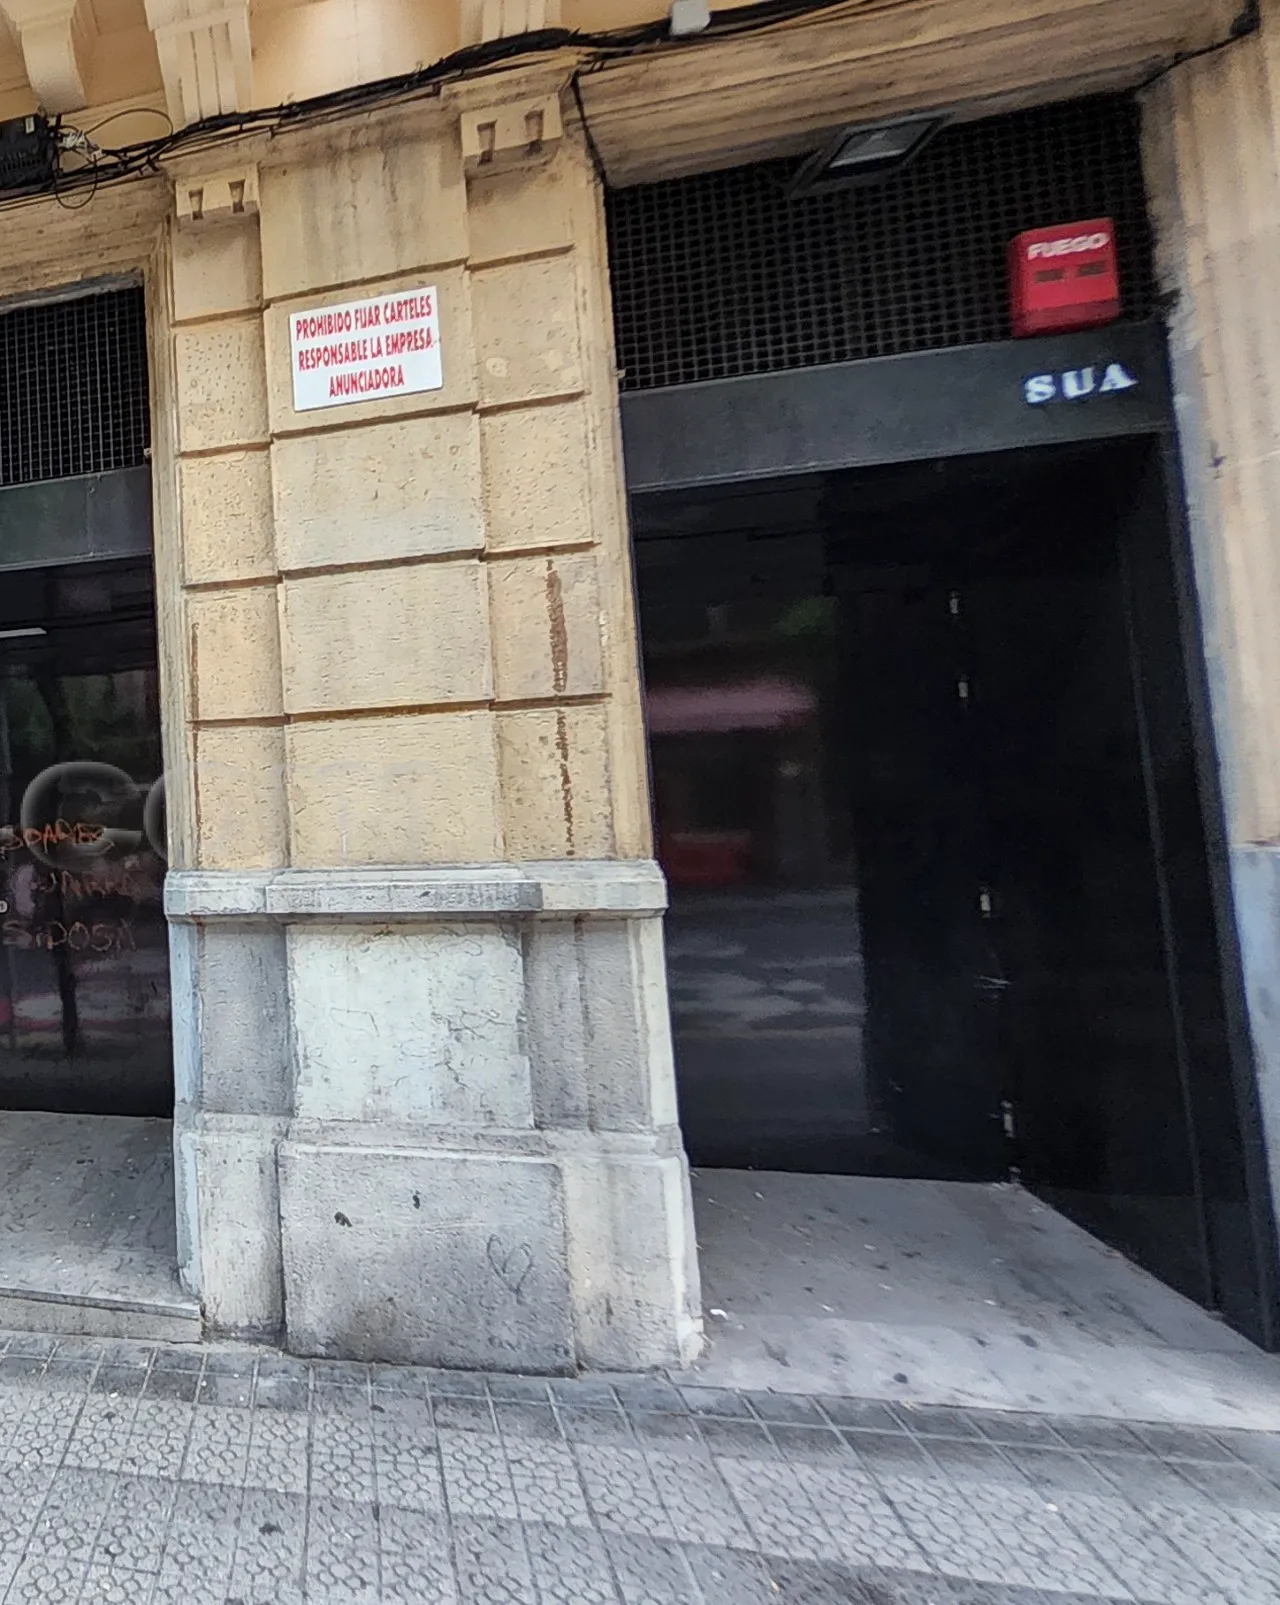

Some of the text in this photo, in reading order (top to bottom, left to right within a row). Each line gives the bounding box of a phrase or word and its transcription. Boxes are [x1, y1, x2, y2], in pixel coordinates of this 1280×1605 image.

[1027, 233, 1110, 260] FUEGO
[297, 310, 352, 340] PROHIBIDO
[384, 295, 432, 324] CARTELES
[298, 338, 368, 371] RESPONSABLE
[370, 336, 383, 358] LA
[329, 365, 404, 397] ANUNCIADORA
[1024, 363, 1138, 403] SUA
